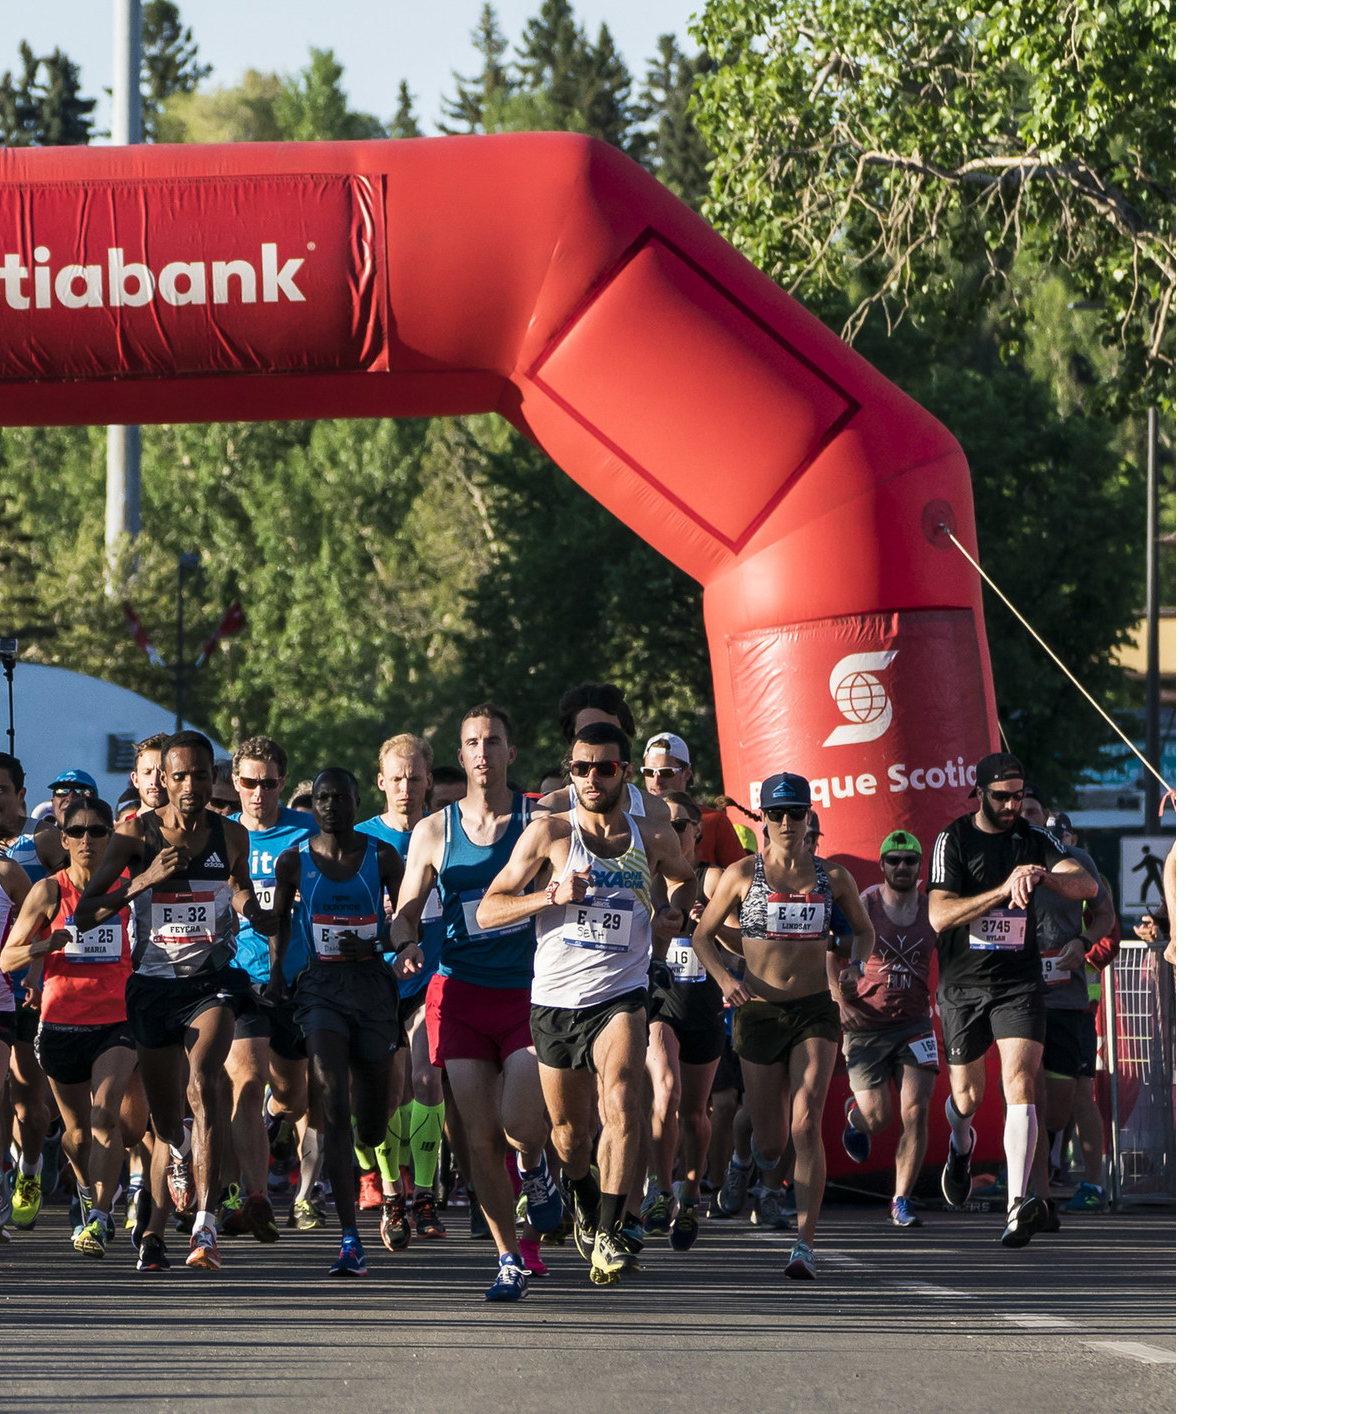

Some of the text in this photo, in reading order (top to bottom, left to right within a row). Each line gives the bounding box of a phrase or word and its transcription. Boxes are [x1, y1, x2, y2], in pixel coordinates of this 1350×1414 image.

[163, 908, 172, 923] E
[188, 907, 207, 922] 32
[578, 910, 587, 925] E
[602, 913, 621, 930] 29
[778, 907, 786, 920] E
[800, 907, 816, 920] 47
[982, 920, 1010, 932] 3745
[98, 929, 113, 944] 25
[322, 929, 330, 942] E
[675, 951, 688, 964] 16
[887, 974, 912, 989] RUN
